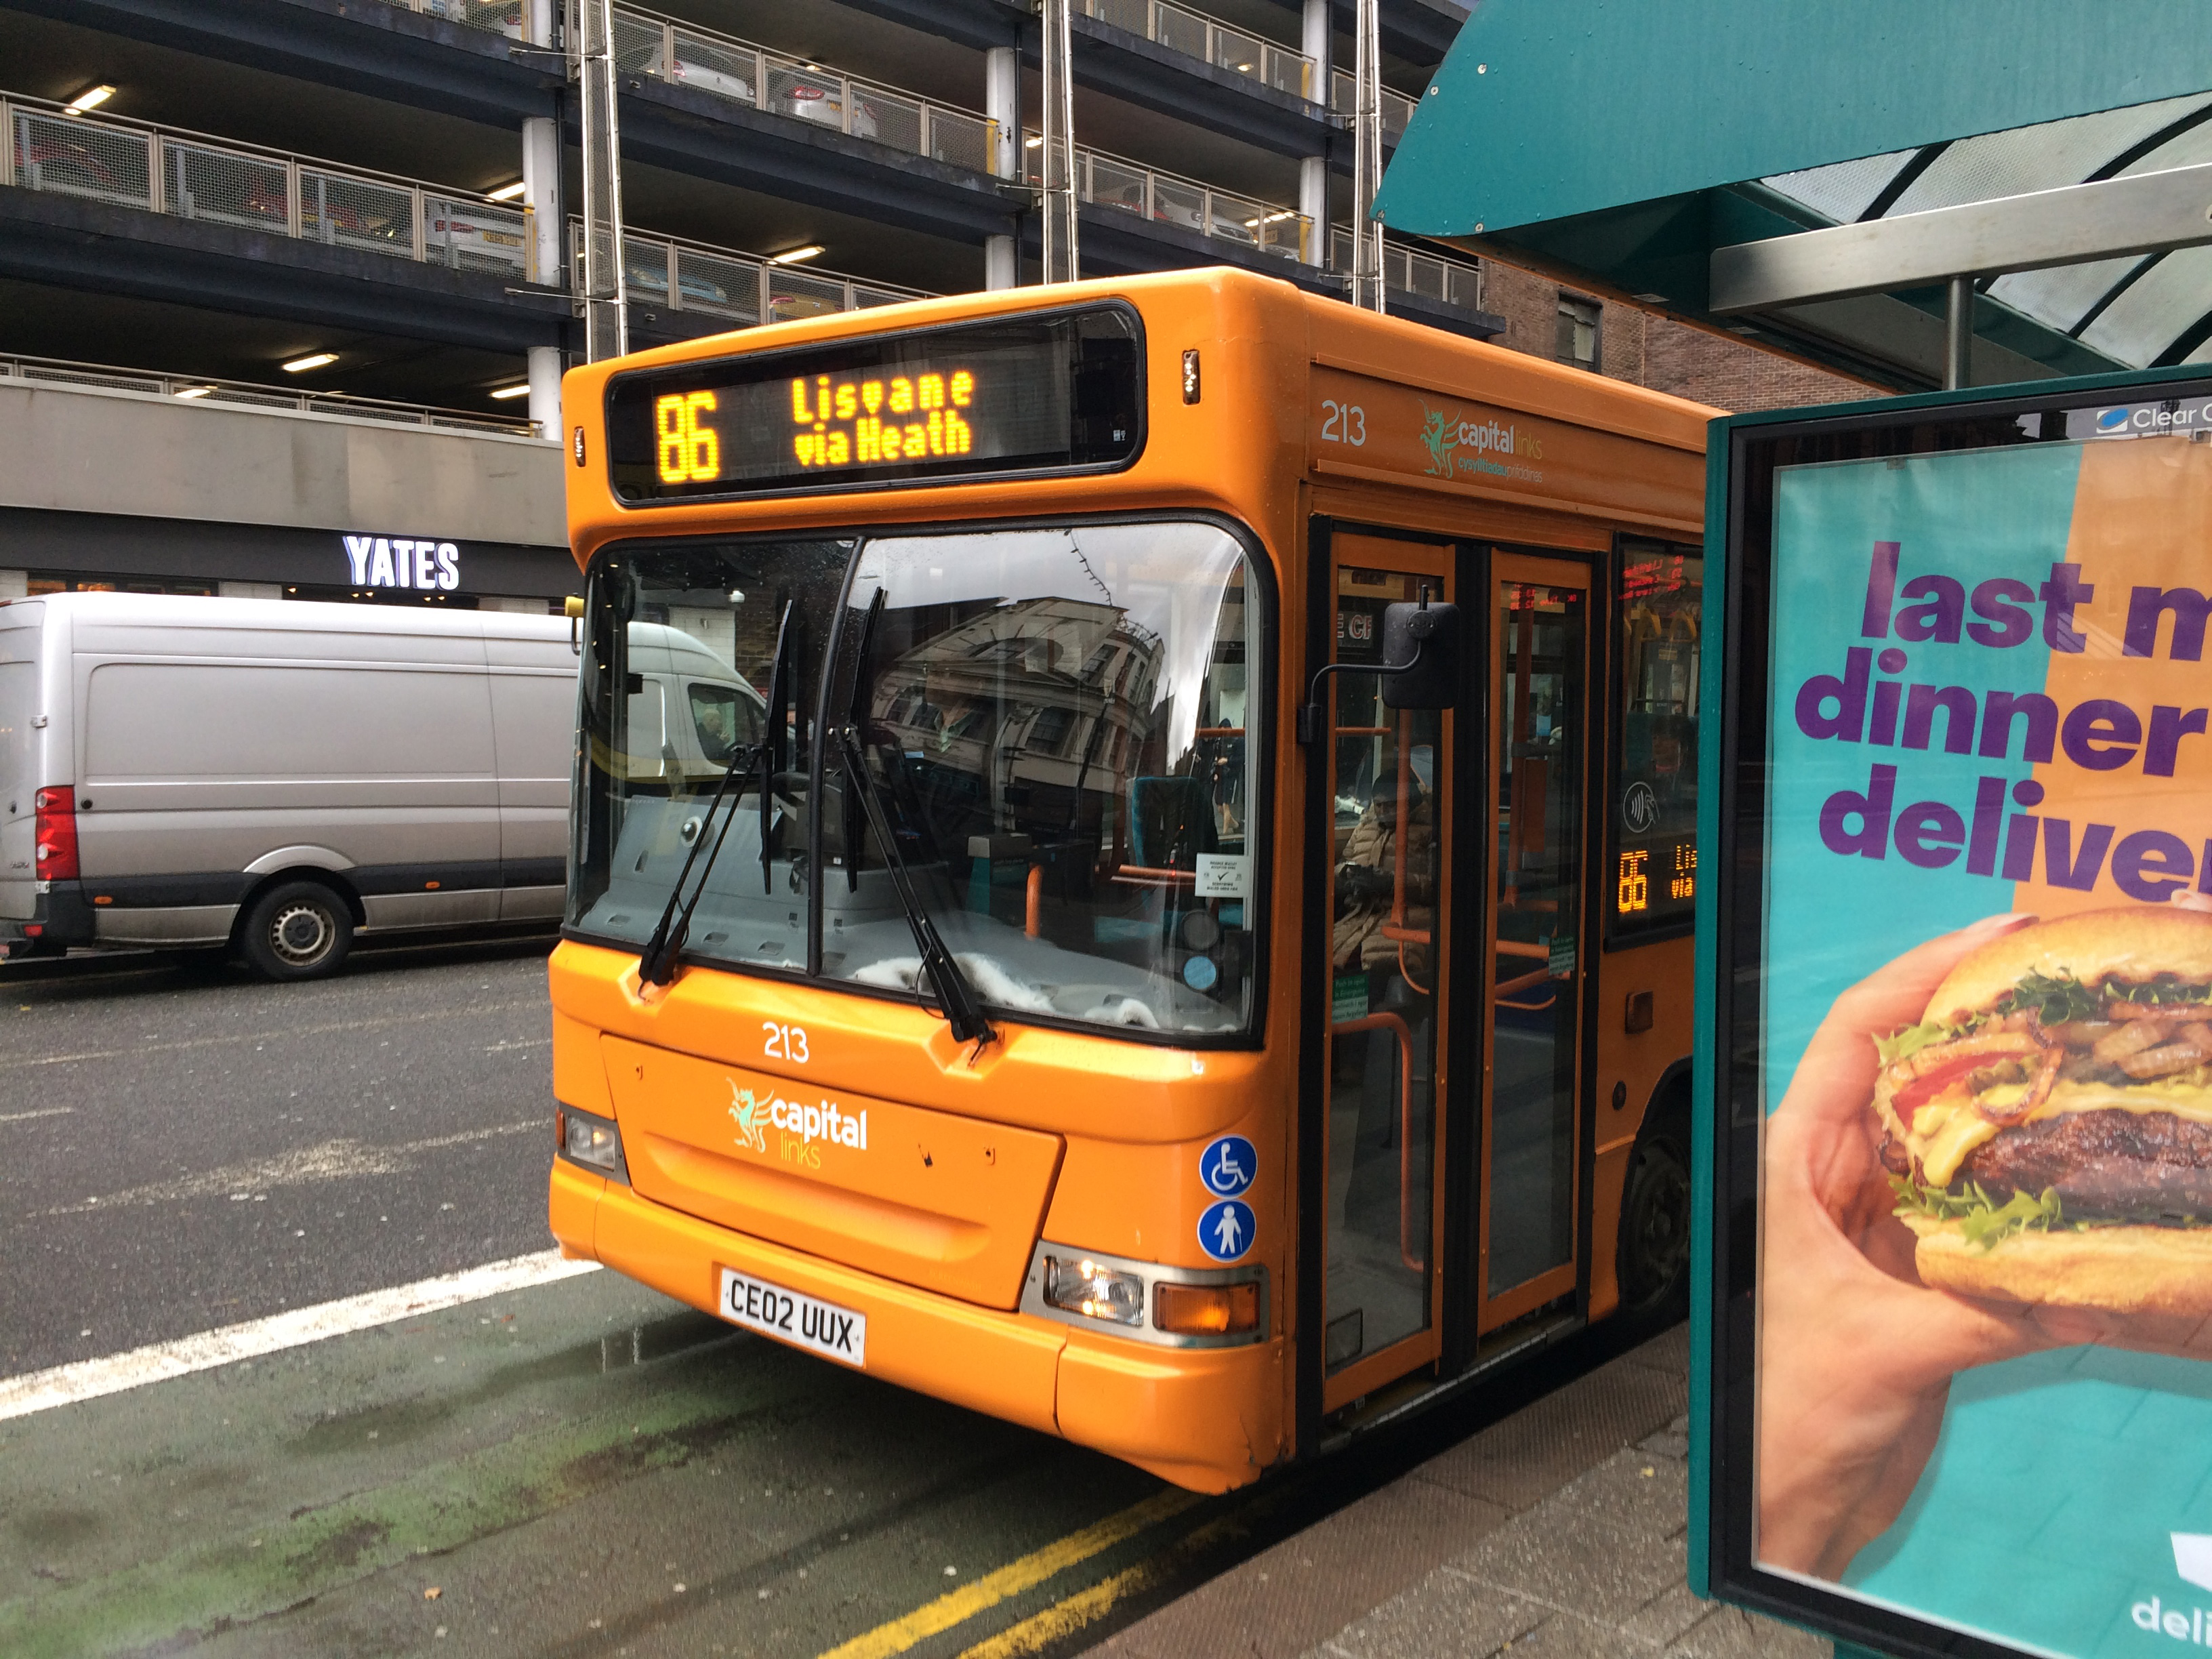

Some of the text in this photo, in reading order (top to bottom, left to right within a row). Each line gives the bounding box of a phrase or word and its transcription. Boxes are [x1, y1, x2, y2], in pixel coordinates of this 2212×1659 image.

[792, 371, 973, 424] Lisvane
[1322, 399, 1366, 447] 213
[2133, 409, 2198, 428] Clear
[657, 390, 720, 483] 86
[794, 409, 971, 466] via Heath
[1458, 419, 1515, 454] capital
[343, 535, 459, 590] YATES
[1861, 541, 2094, 654] last
[1795, 646, 2209, 777] dinner
[1819, 763, 2212, 903] delive
[1618, 851, 1647, 912] 86
[762, 1021, 809, 1063] 213
[771, 1098, 867, 1150] capital
[781, 1132, 821, 1169] links
[731, 1279, 853, 1353] CE02 UUX
